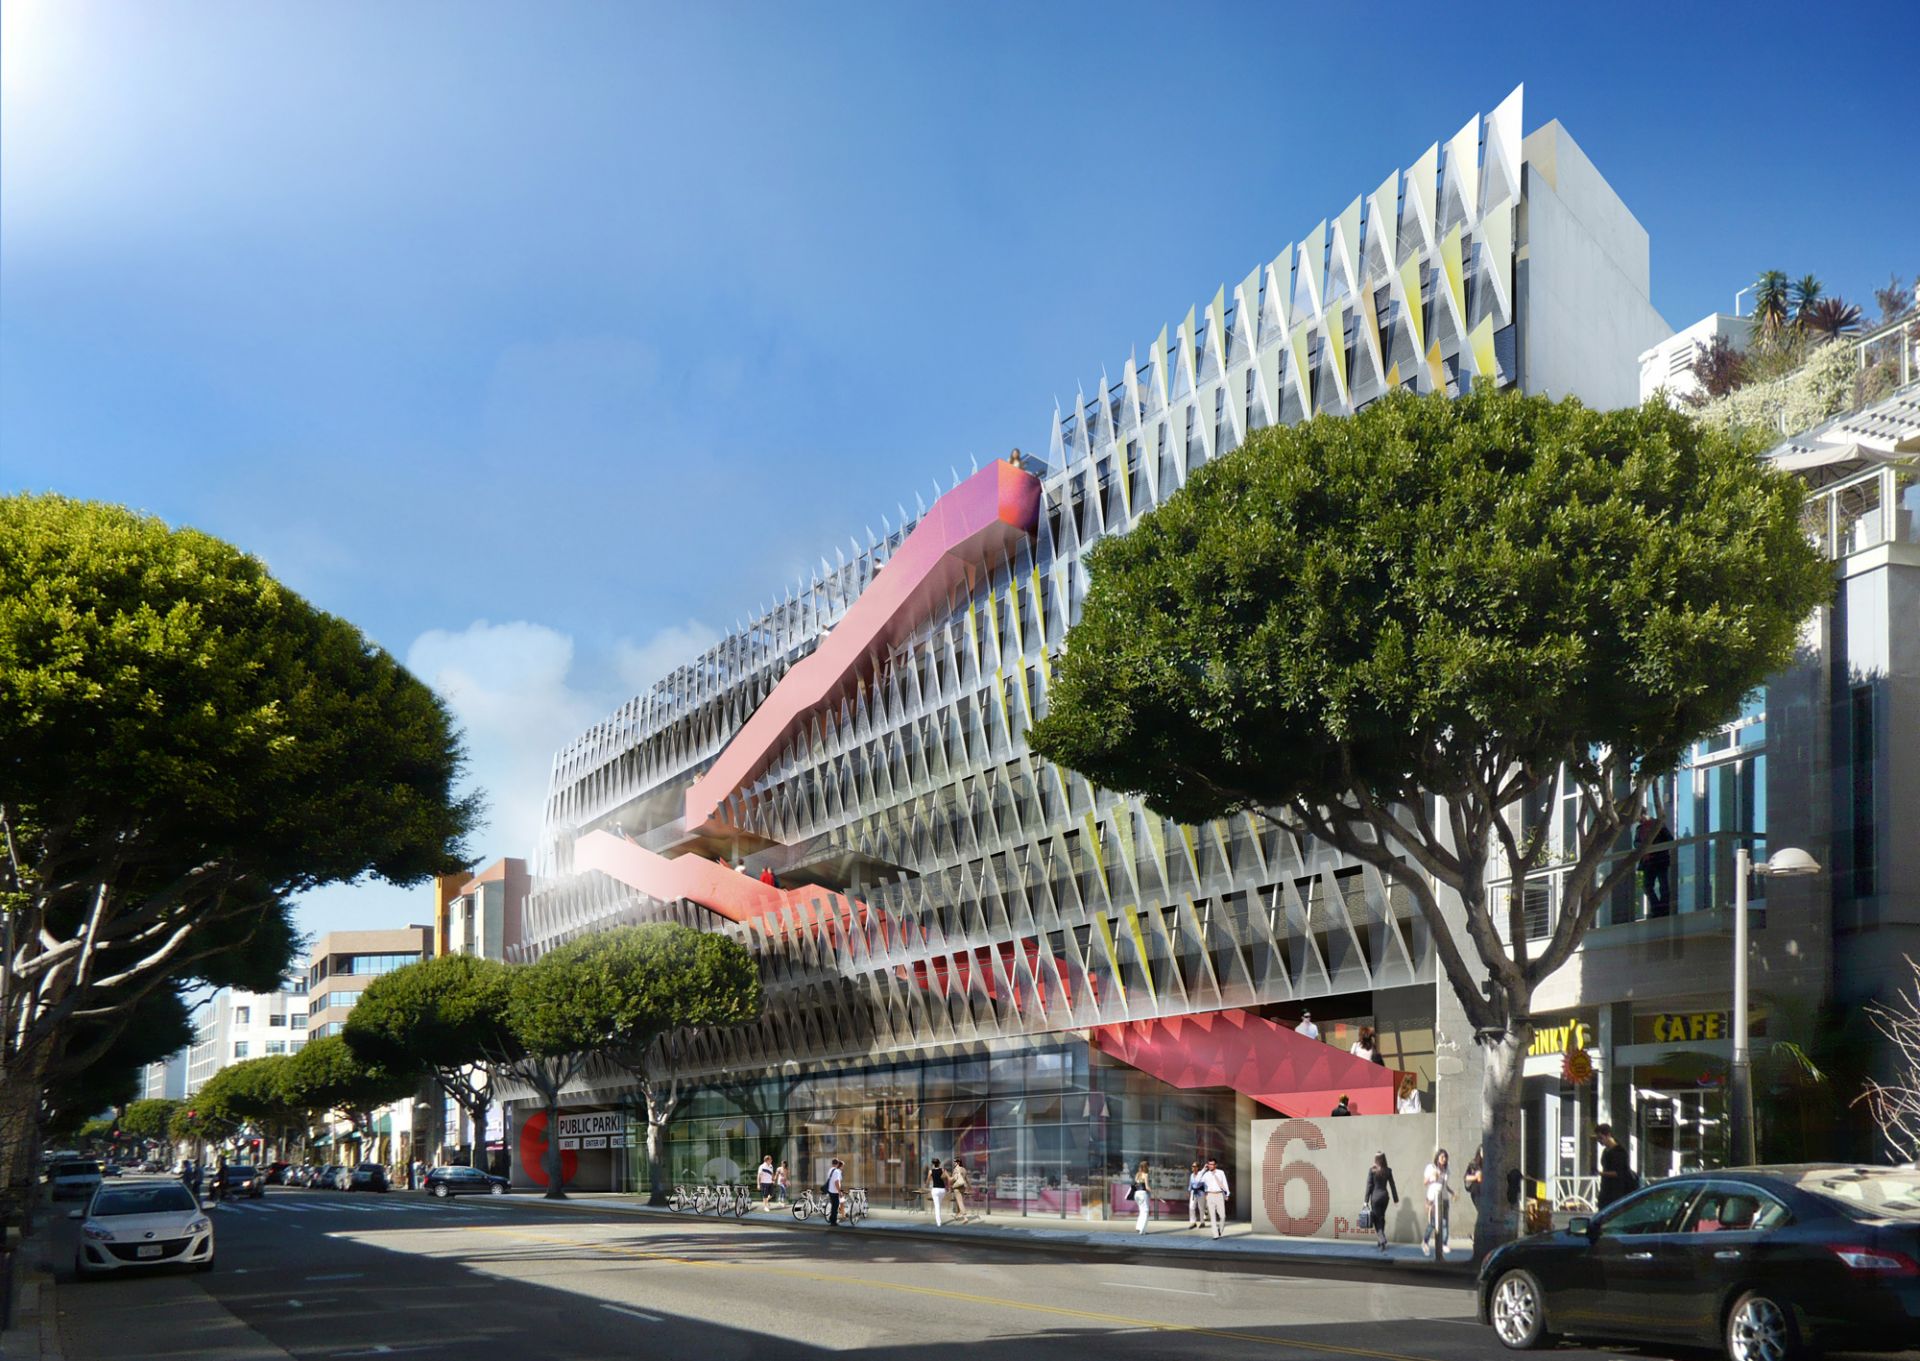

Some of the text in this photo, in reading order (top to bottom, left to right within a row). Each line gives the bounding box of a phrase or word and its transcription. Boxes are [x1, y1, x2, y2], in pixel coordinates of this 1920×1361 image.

[1654, 1012, 1719, 1041] CAFE
[560, 1117, 591, 1134] PUBLIC
[585, 1138, 606, 1147] ENTER UP
[1262, 1118, 1330, 1237] 6
